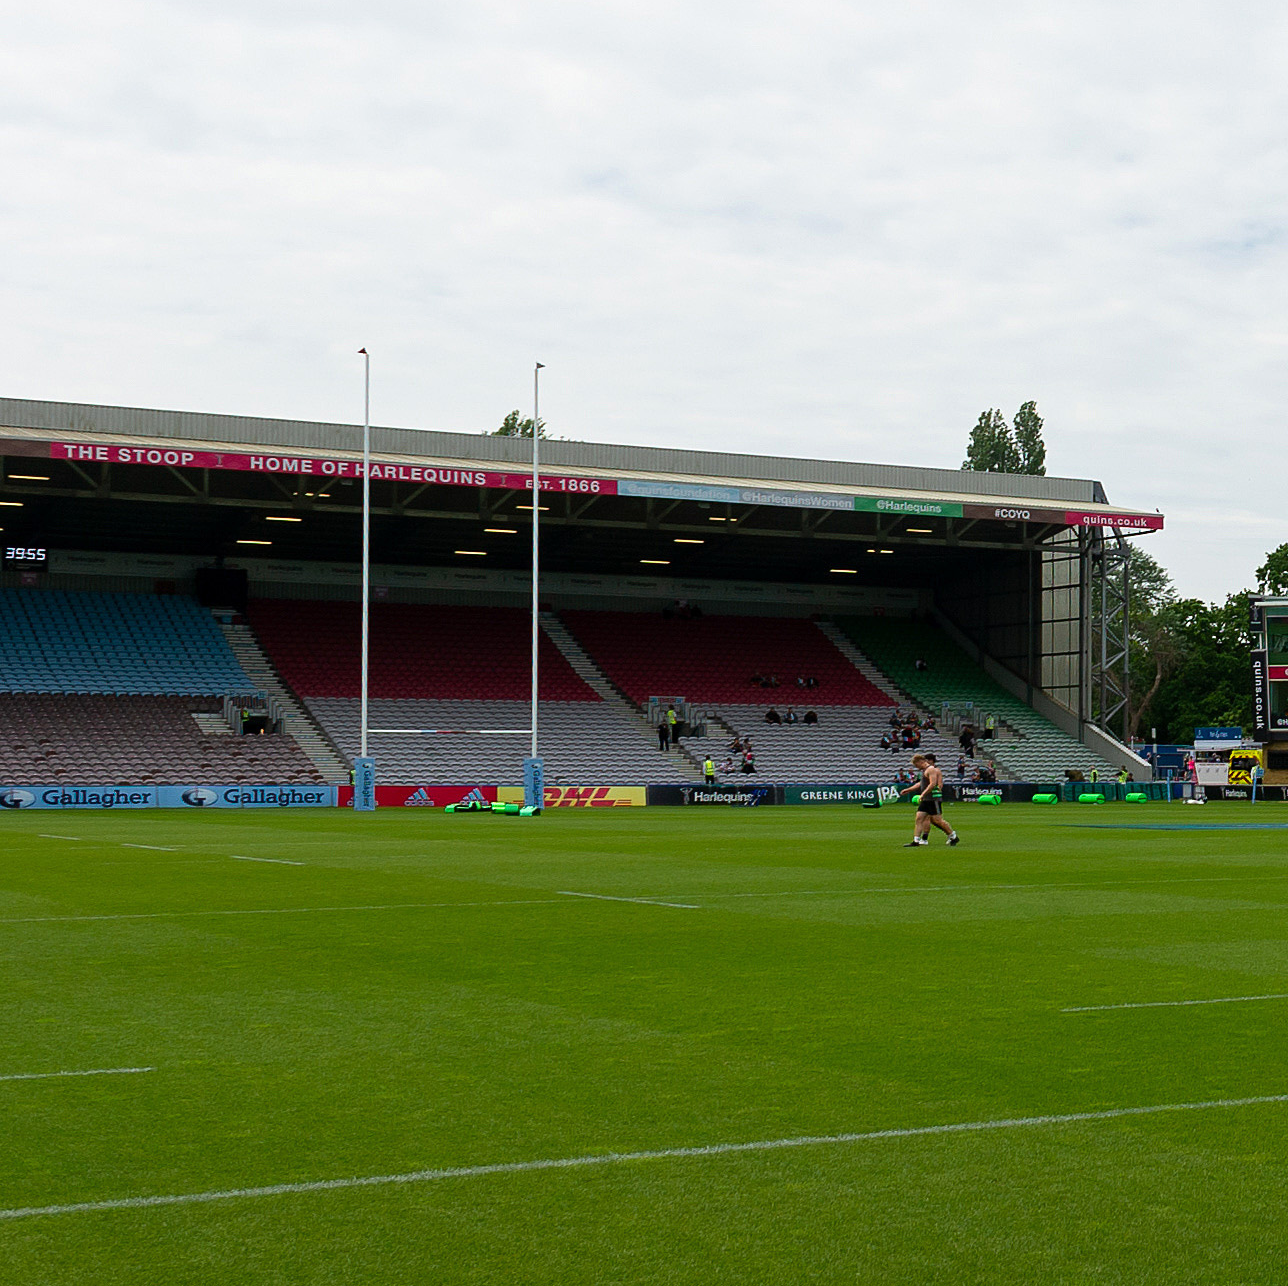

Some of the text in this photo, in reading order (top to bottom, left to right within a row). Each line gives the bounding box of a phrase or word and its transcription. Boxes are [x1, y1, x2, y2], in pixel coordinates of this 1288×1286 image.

[63, 444, 195, 465] THE STOOP
[250, 455, 487, 486] HOME OF HARLEQUINS
[559, 478, 601, 493] 1866
[742, 491, 852, 509] @HarlequinsWomen
[876, 499, 943, 515] @Harlequins
[1082, 515, 1148, 528] quins.co.uk
[1253, 660, 1265, 729] quins.co.uk
[42, 789, 151, 808] Gallagher
[223, 788, 325, 807] Gallagher
[543, 787, 611, 807] DHL
[694, 791, 753, 803] Harlequins
[801, 786, 901, 800] GREENE KING IPA
